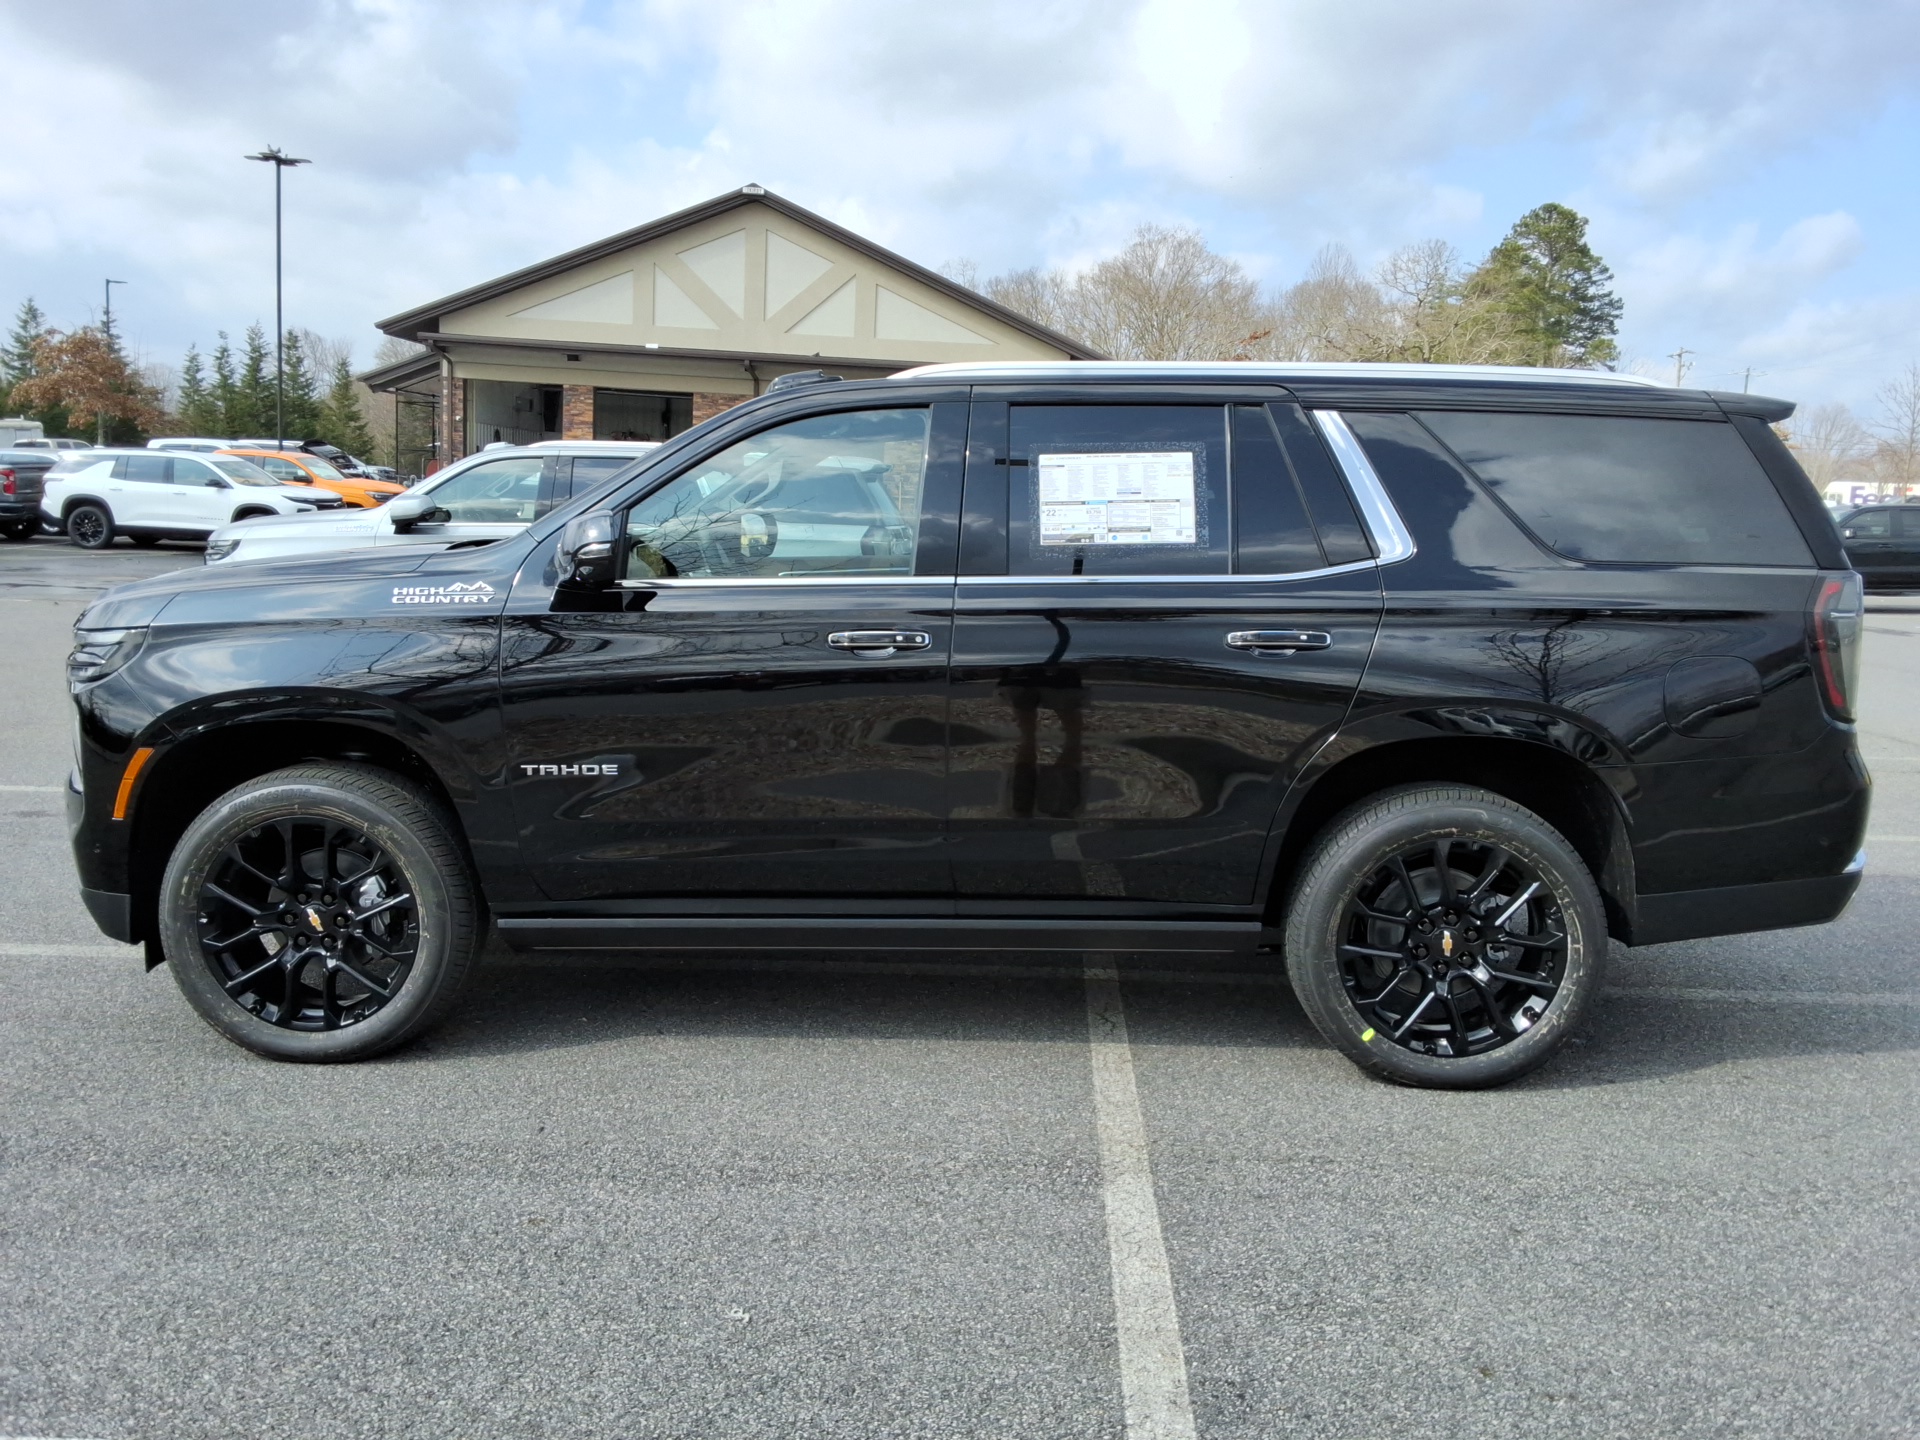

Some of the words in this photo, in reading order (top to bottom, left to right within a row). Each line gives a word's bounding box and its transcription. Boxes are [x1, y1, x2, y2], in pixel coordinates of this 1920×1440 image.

[1046, 509, 1057, 517] 22
[393, 587, 444, 595] HIGH
[391, 595, 495, 604] COUNTRY
[520, 764, 618, 776] TAHOE
